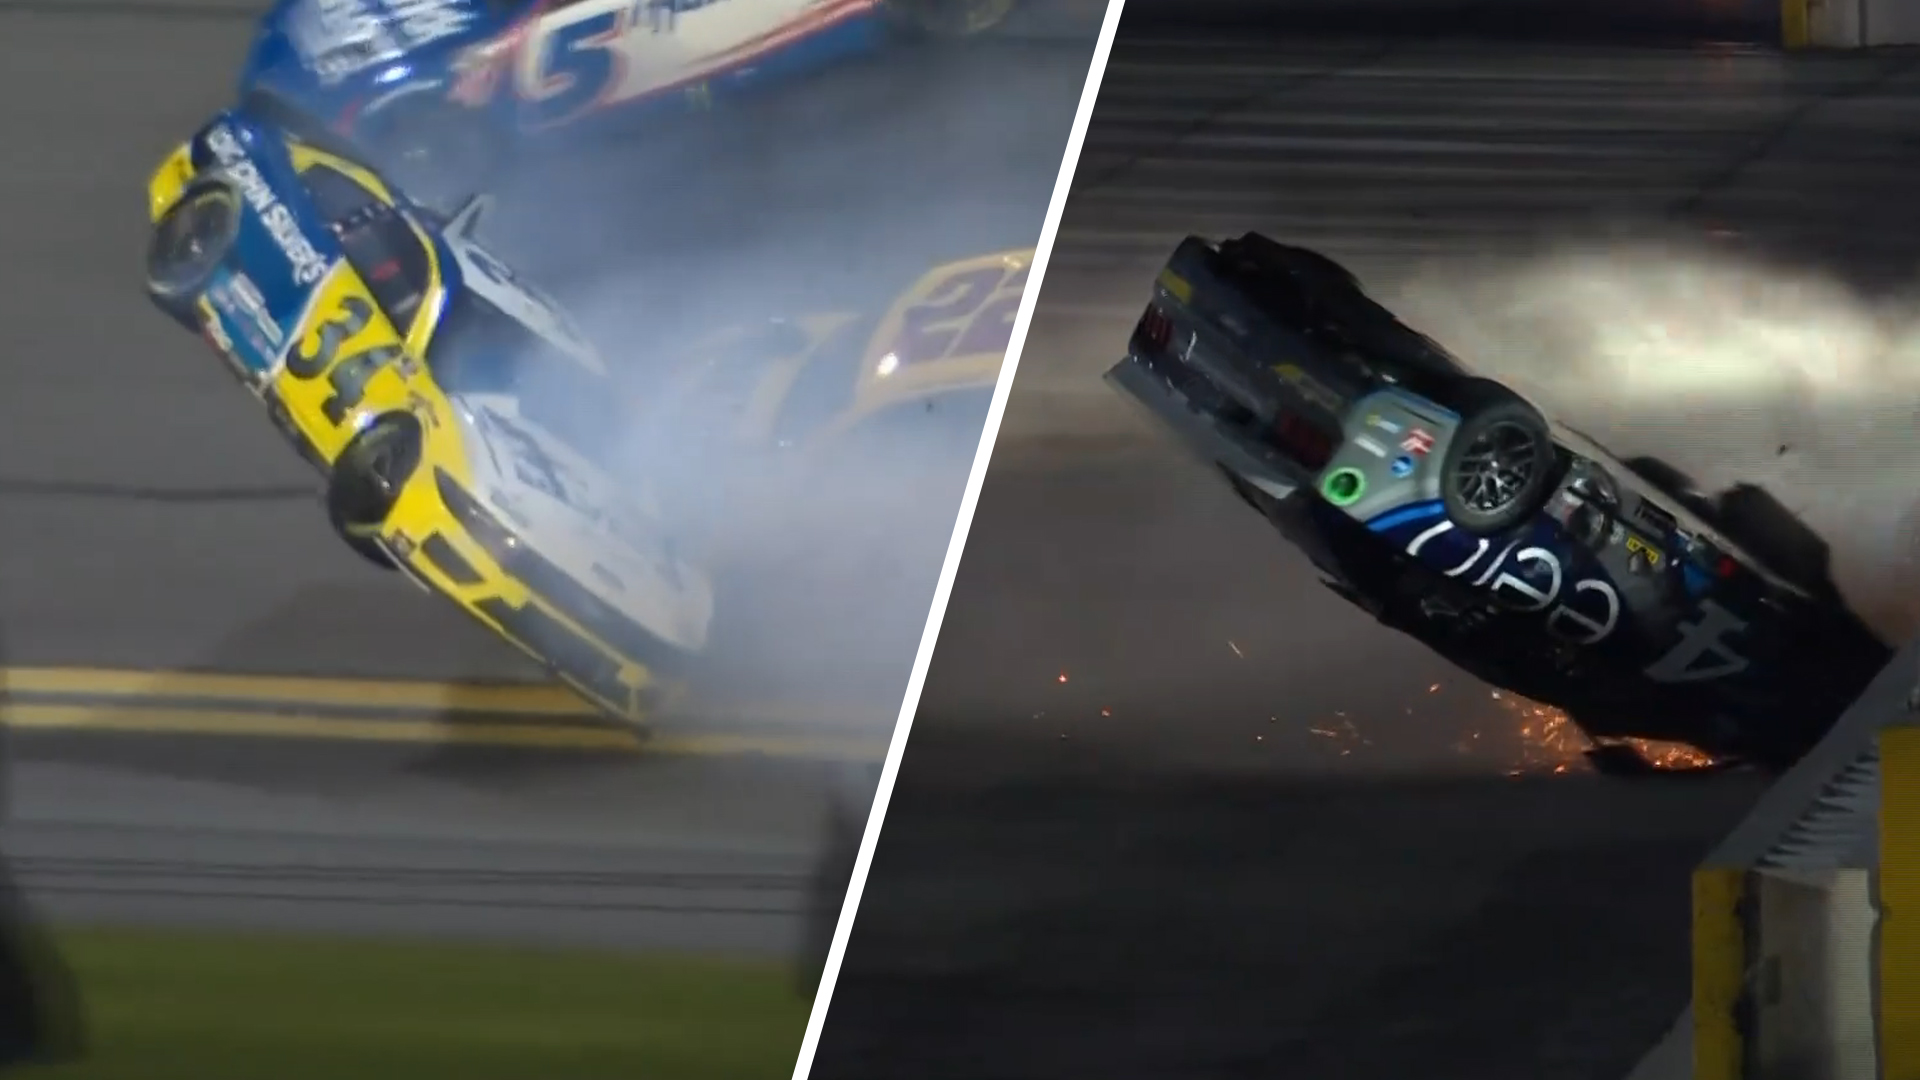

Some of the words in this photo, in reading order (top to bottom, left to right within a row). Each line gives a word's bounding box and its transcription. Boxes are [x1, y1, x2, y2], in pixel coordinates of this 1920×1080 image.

[517, 6, 628, 134] 5
[286, 296, 404, 428] 31
[1643, 598, 1749, 682] 4
